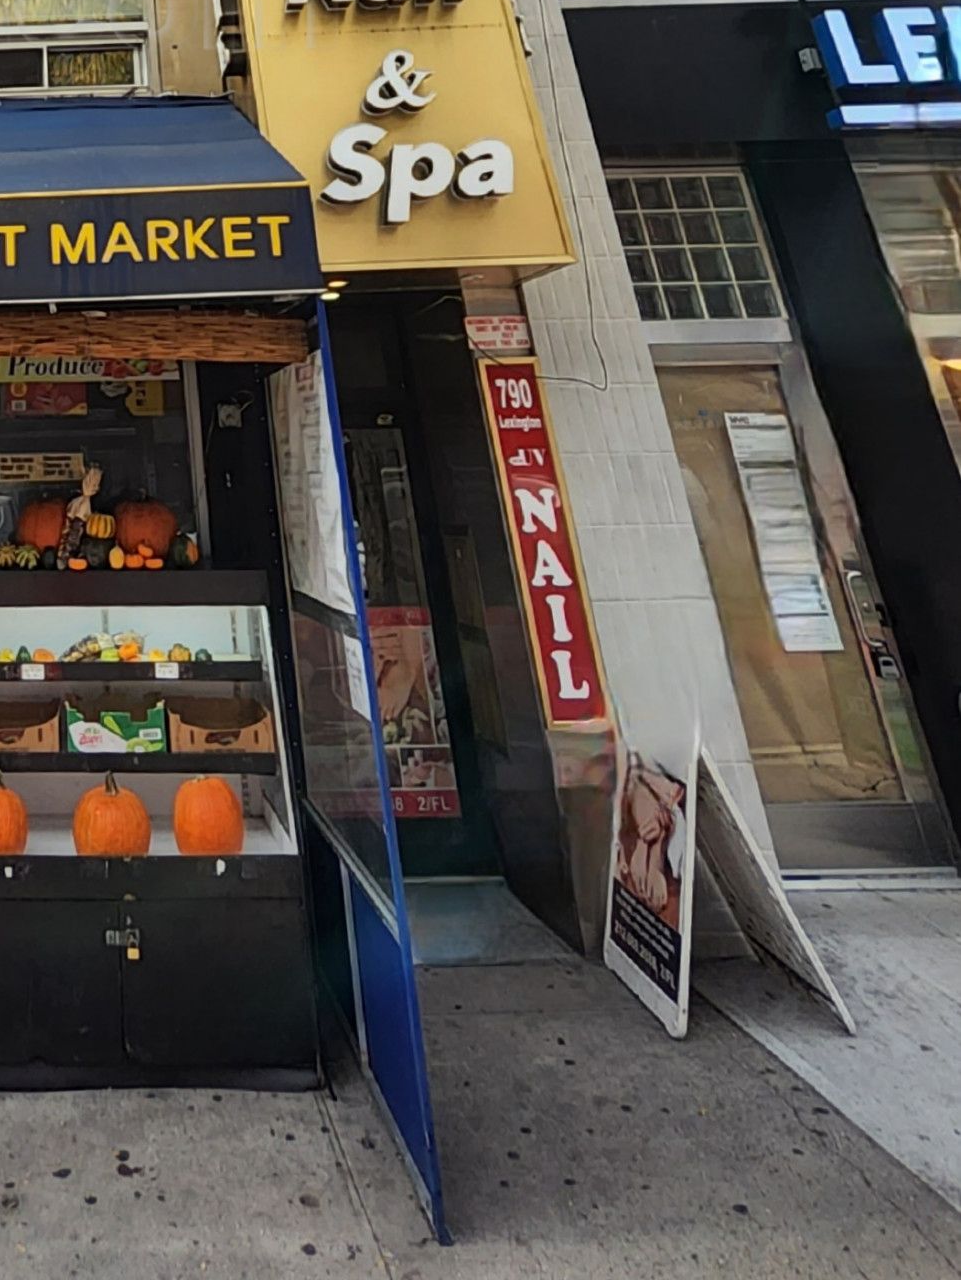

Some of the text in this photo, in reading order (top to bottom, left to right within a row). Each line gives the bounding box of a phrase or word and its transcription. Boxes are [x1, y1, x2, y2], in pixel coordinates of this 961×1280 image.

[363, 49, 436, 115] &
[321, 122, 514, 226] Spa
[50, 214, 292, 268] MARKET
[8, 356, 105, 377] Produce
[494, 378, 533, 409] 790
[514, 488, 590, 701] NAIL
